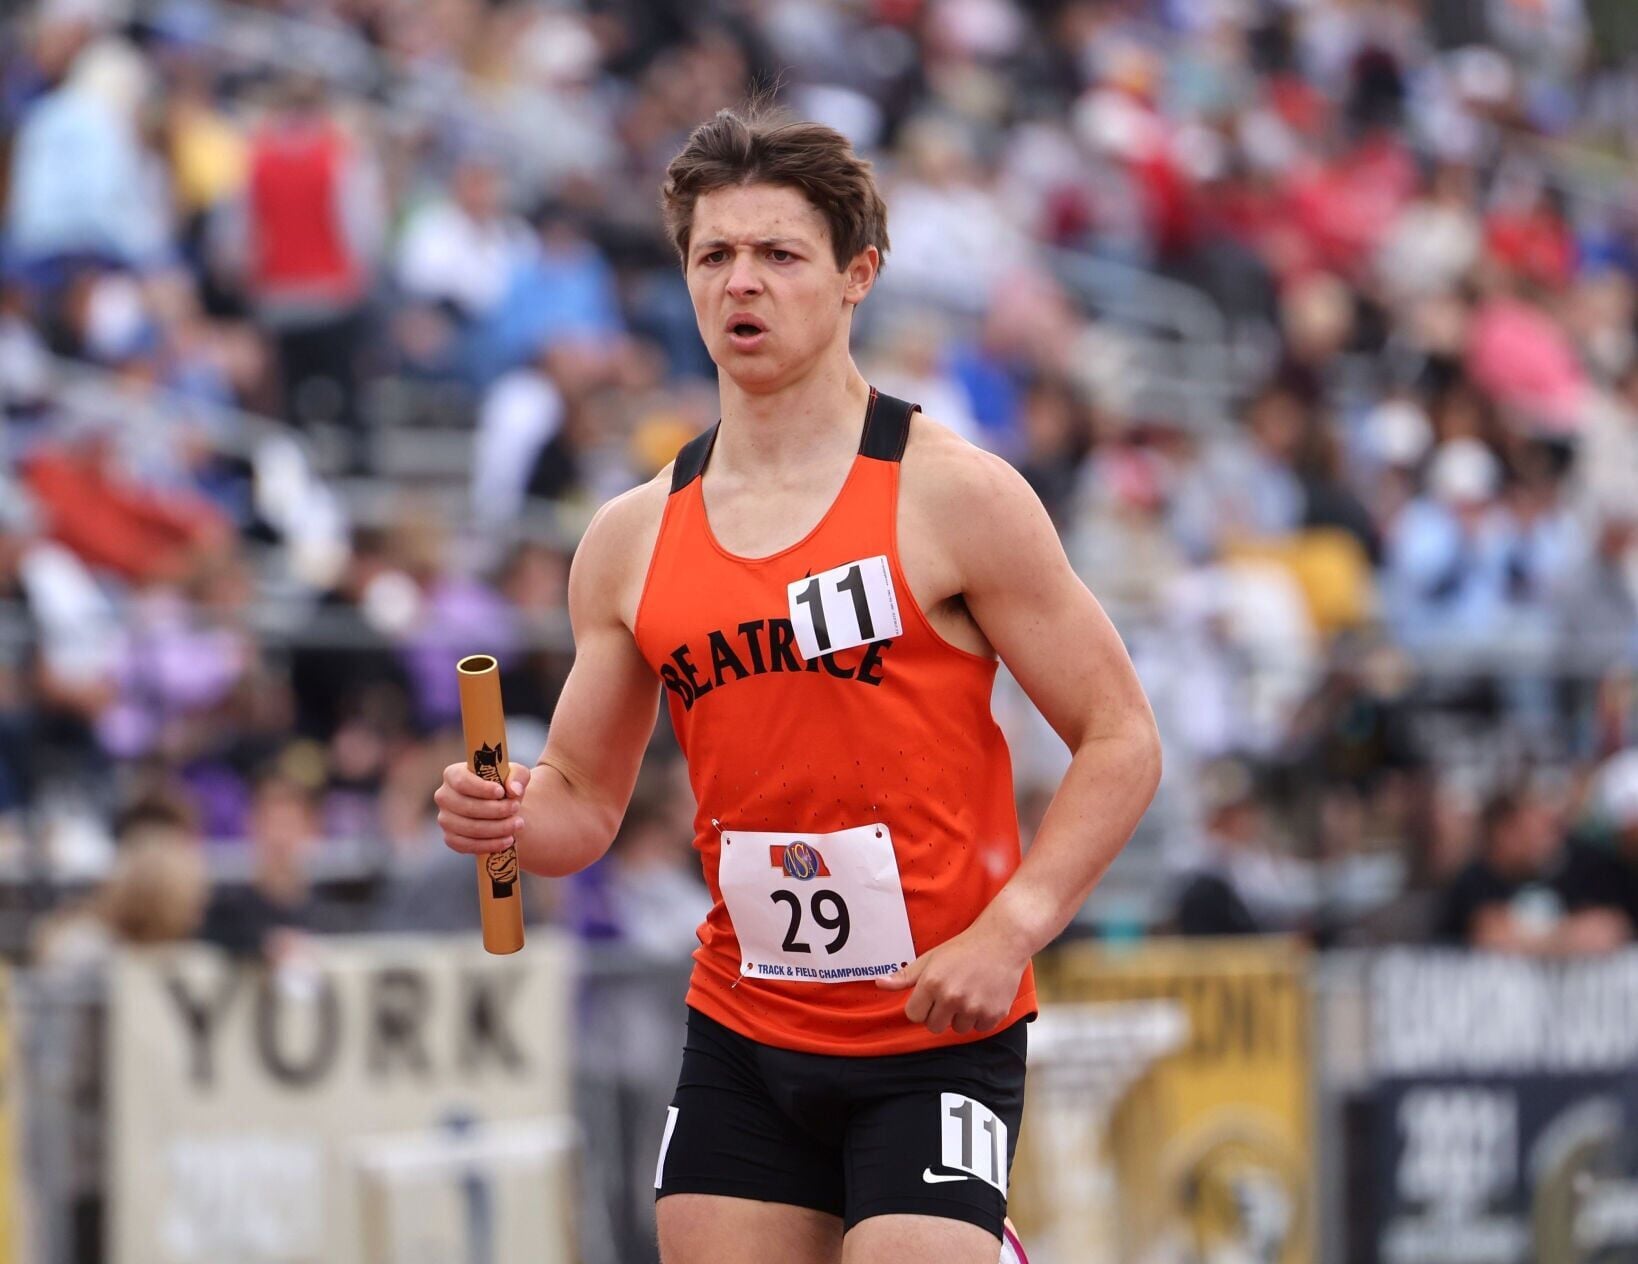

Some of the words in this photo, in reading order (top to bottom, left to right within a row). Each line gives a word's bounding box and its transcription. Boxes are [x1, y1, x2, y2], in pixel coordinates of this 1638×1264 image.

[796, 564, 875, 651] 11
[660, 618, 893, 712] BEATRCE
[770, 889, 850, 955] 29
[758, 963, 785, 976] TRACK
[787, 966, 794, 976] &
[795, 966, 818, 978] FIELD
[819, 962, 898, 979] CHAMPIONSHIPS
[162, 966, 536, 1090] YORK
[950, 1099, 1000, 1185] 11
